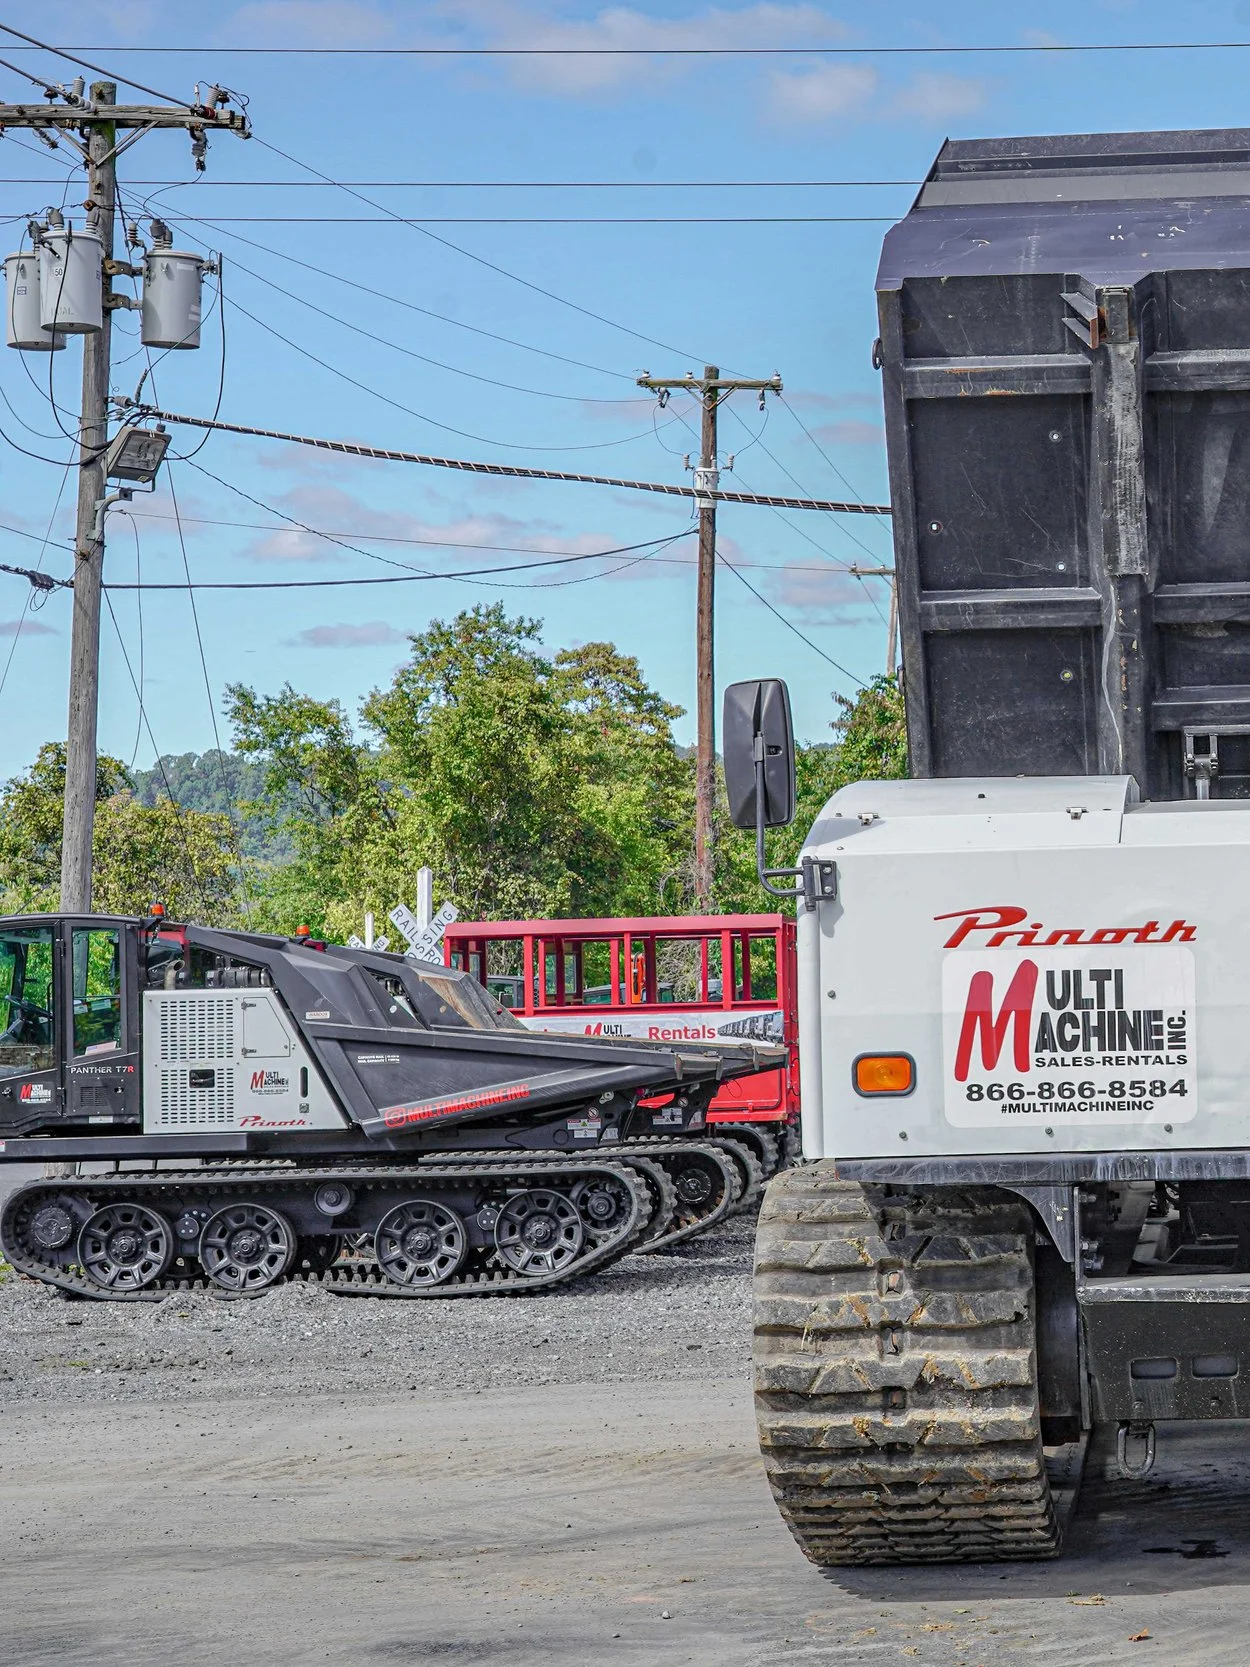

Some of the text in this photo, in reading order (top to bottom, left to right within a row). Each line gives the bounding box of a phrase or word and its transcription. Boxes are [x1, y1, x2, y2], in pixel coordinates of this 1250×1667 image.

[393, 909, 418, 942] RAIL
[933, 905, 1197, 948] Prinoth
[407, 910, 453, 960] OSSING
[648, 1025, 717, 1041] Rentals
[1034, 1054, 1188, 1068] SALES-RENTALS
[70, 1065, 135, 1074] PANTHER T7R
[965, 1078, 1188, 1102] 866-866-8584
[1000, 1100, 1155, 1114] #MULTIMACHINEINC
[237, 1115, 306, 1127] Prinoth
